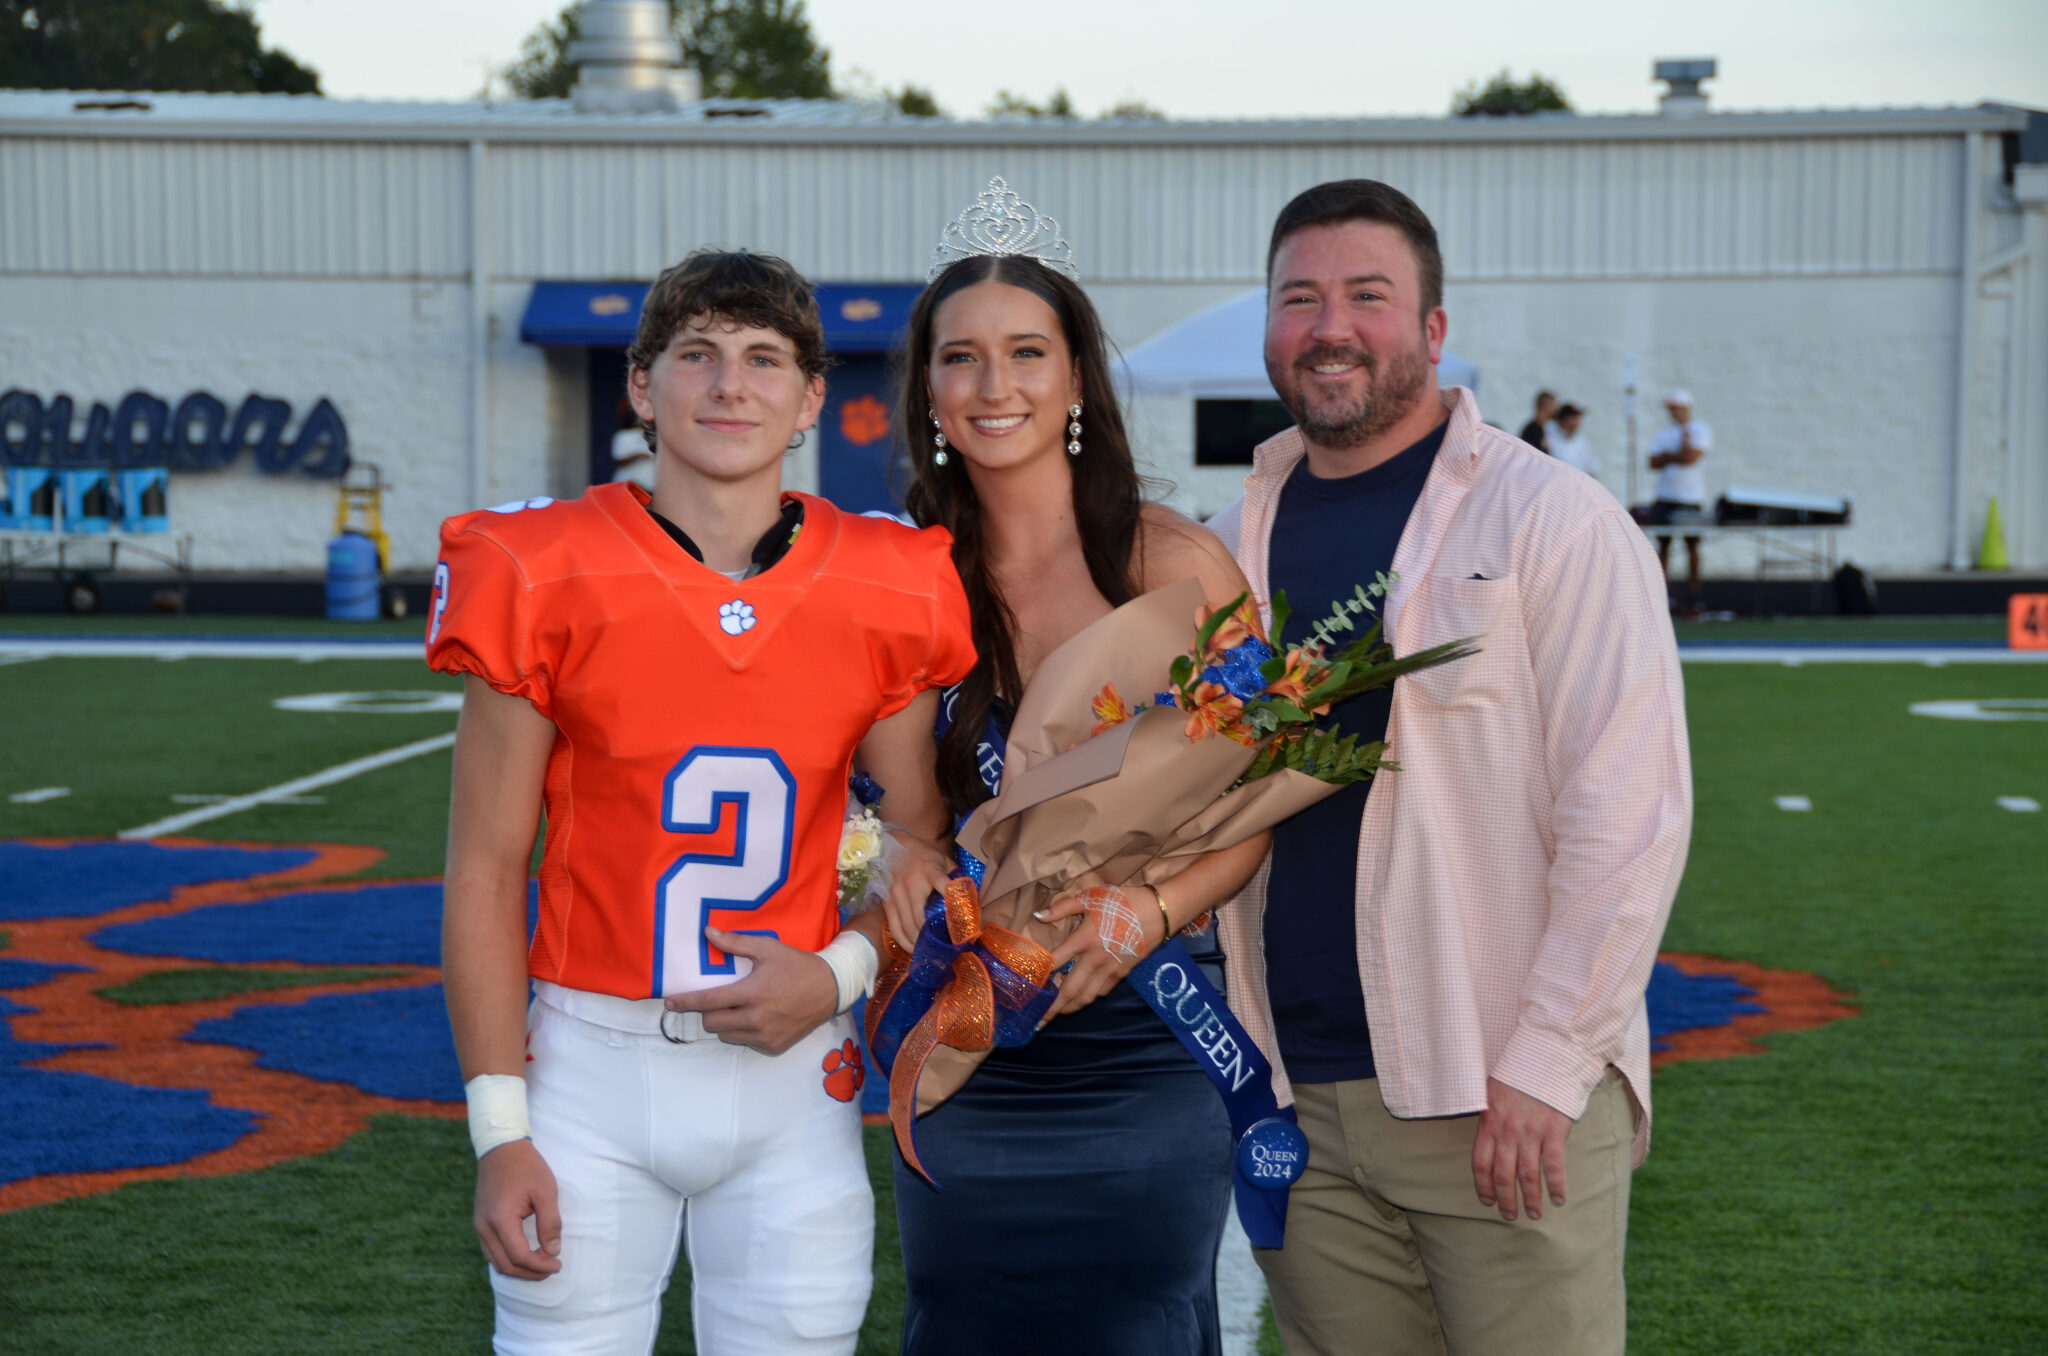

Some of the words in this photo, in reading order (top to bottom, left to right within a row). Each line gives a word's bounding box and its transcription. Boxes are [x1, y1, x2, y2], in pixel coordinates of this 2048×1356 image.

[651, 745, 797, 998] 2
[1148, 961, 1256, 1093] QUEEN
[1251, 1144, 1299, 1163] QUEEN
[1252, 1162, 1293, 1179] 2024
